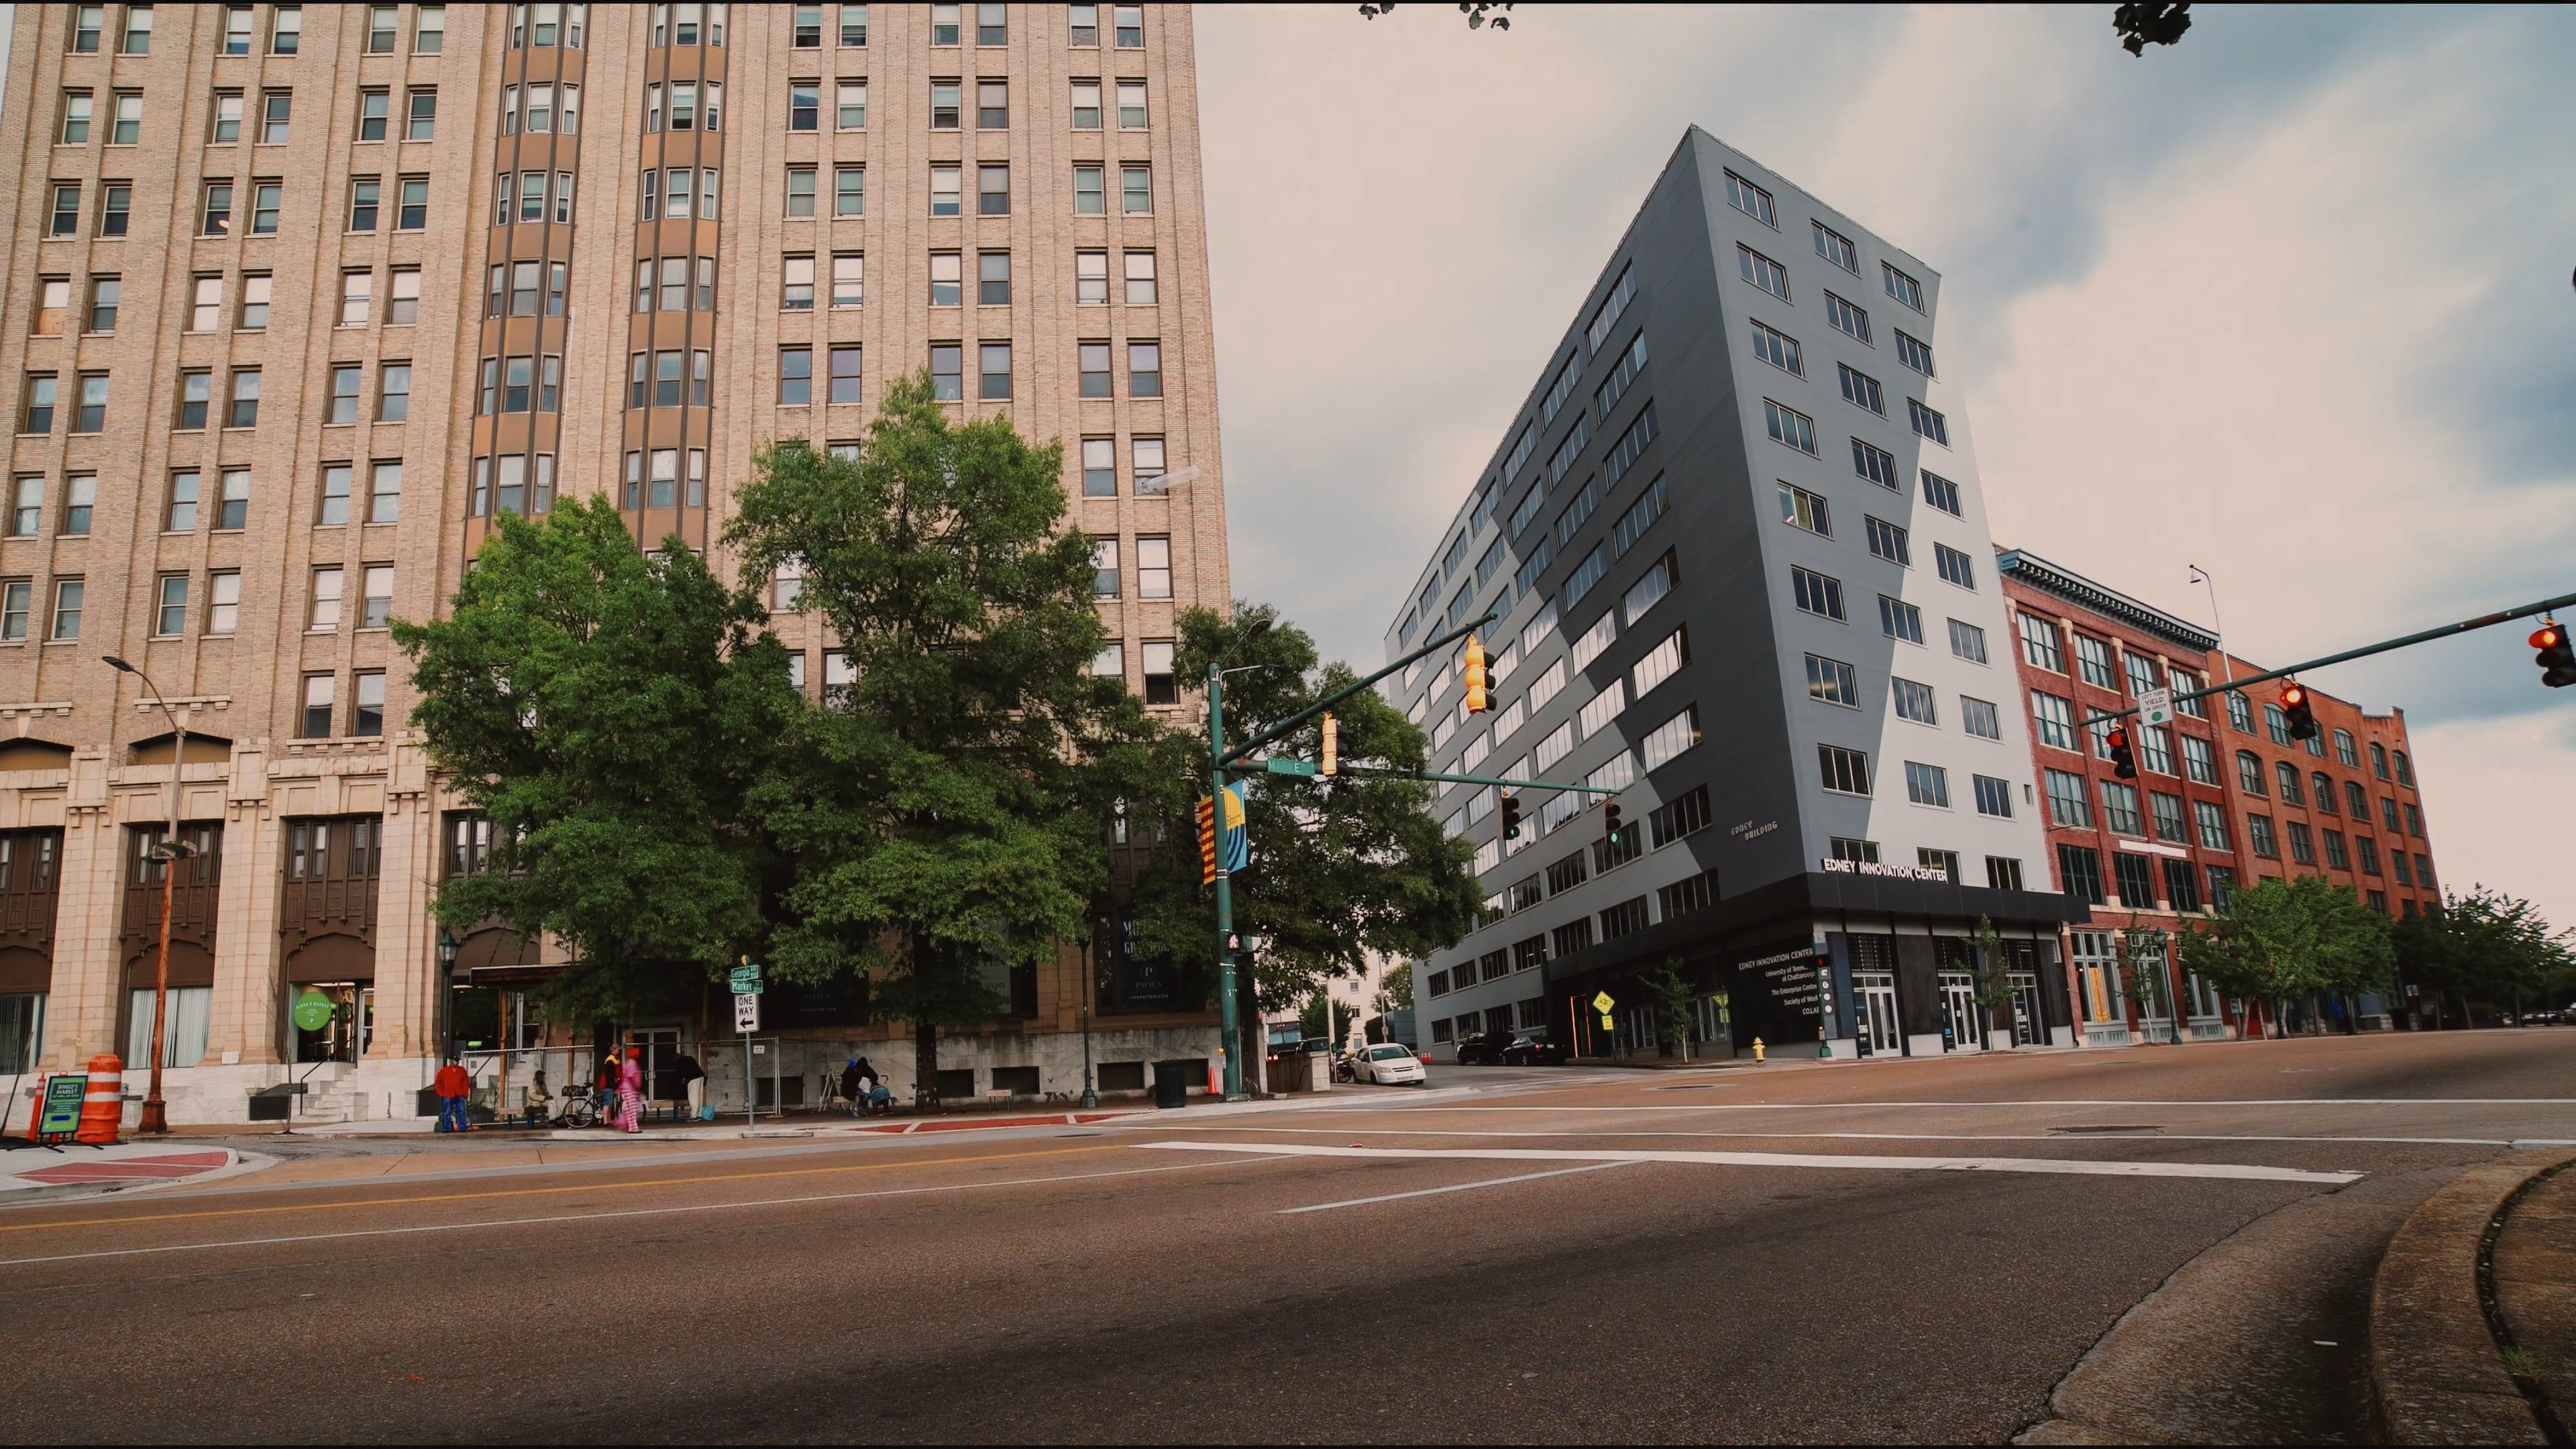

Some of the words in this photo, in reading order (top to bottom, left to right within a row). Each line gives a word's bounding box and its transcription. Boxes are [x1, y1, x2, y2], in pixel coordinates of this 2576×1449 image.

[2145, 696, 2163, 706] YIELD
[1731, 820, 1752, 836] EDNEY
[1745, 820, 1778, 841] BUILDING
[1824, 858, 1856, 873] EDNEY
[1859, 861, 1913, 879] INNOVATION
[1915, 867, 1948, 883] CENTER
[1739, 960, 1756, 971] EDNEY
[1756, 953, 1790, 967] INNOVATION
[1790, 948, 1813, 959] CENTER
[732, 969, 750, 979] Georgia
[1765, 968, 1786, 977] University
[733, 981, 752, 991] Market
[1780, 986, 1802, 995] Enterprise
[739, 996, 753, 1006] ONE
[1784, 998, 1801, 1006] Society
[739, 1006, 754, 1016] WAY
